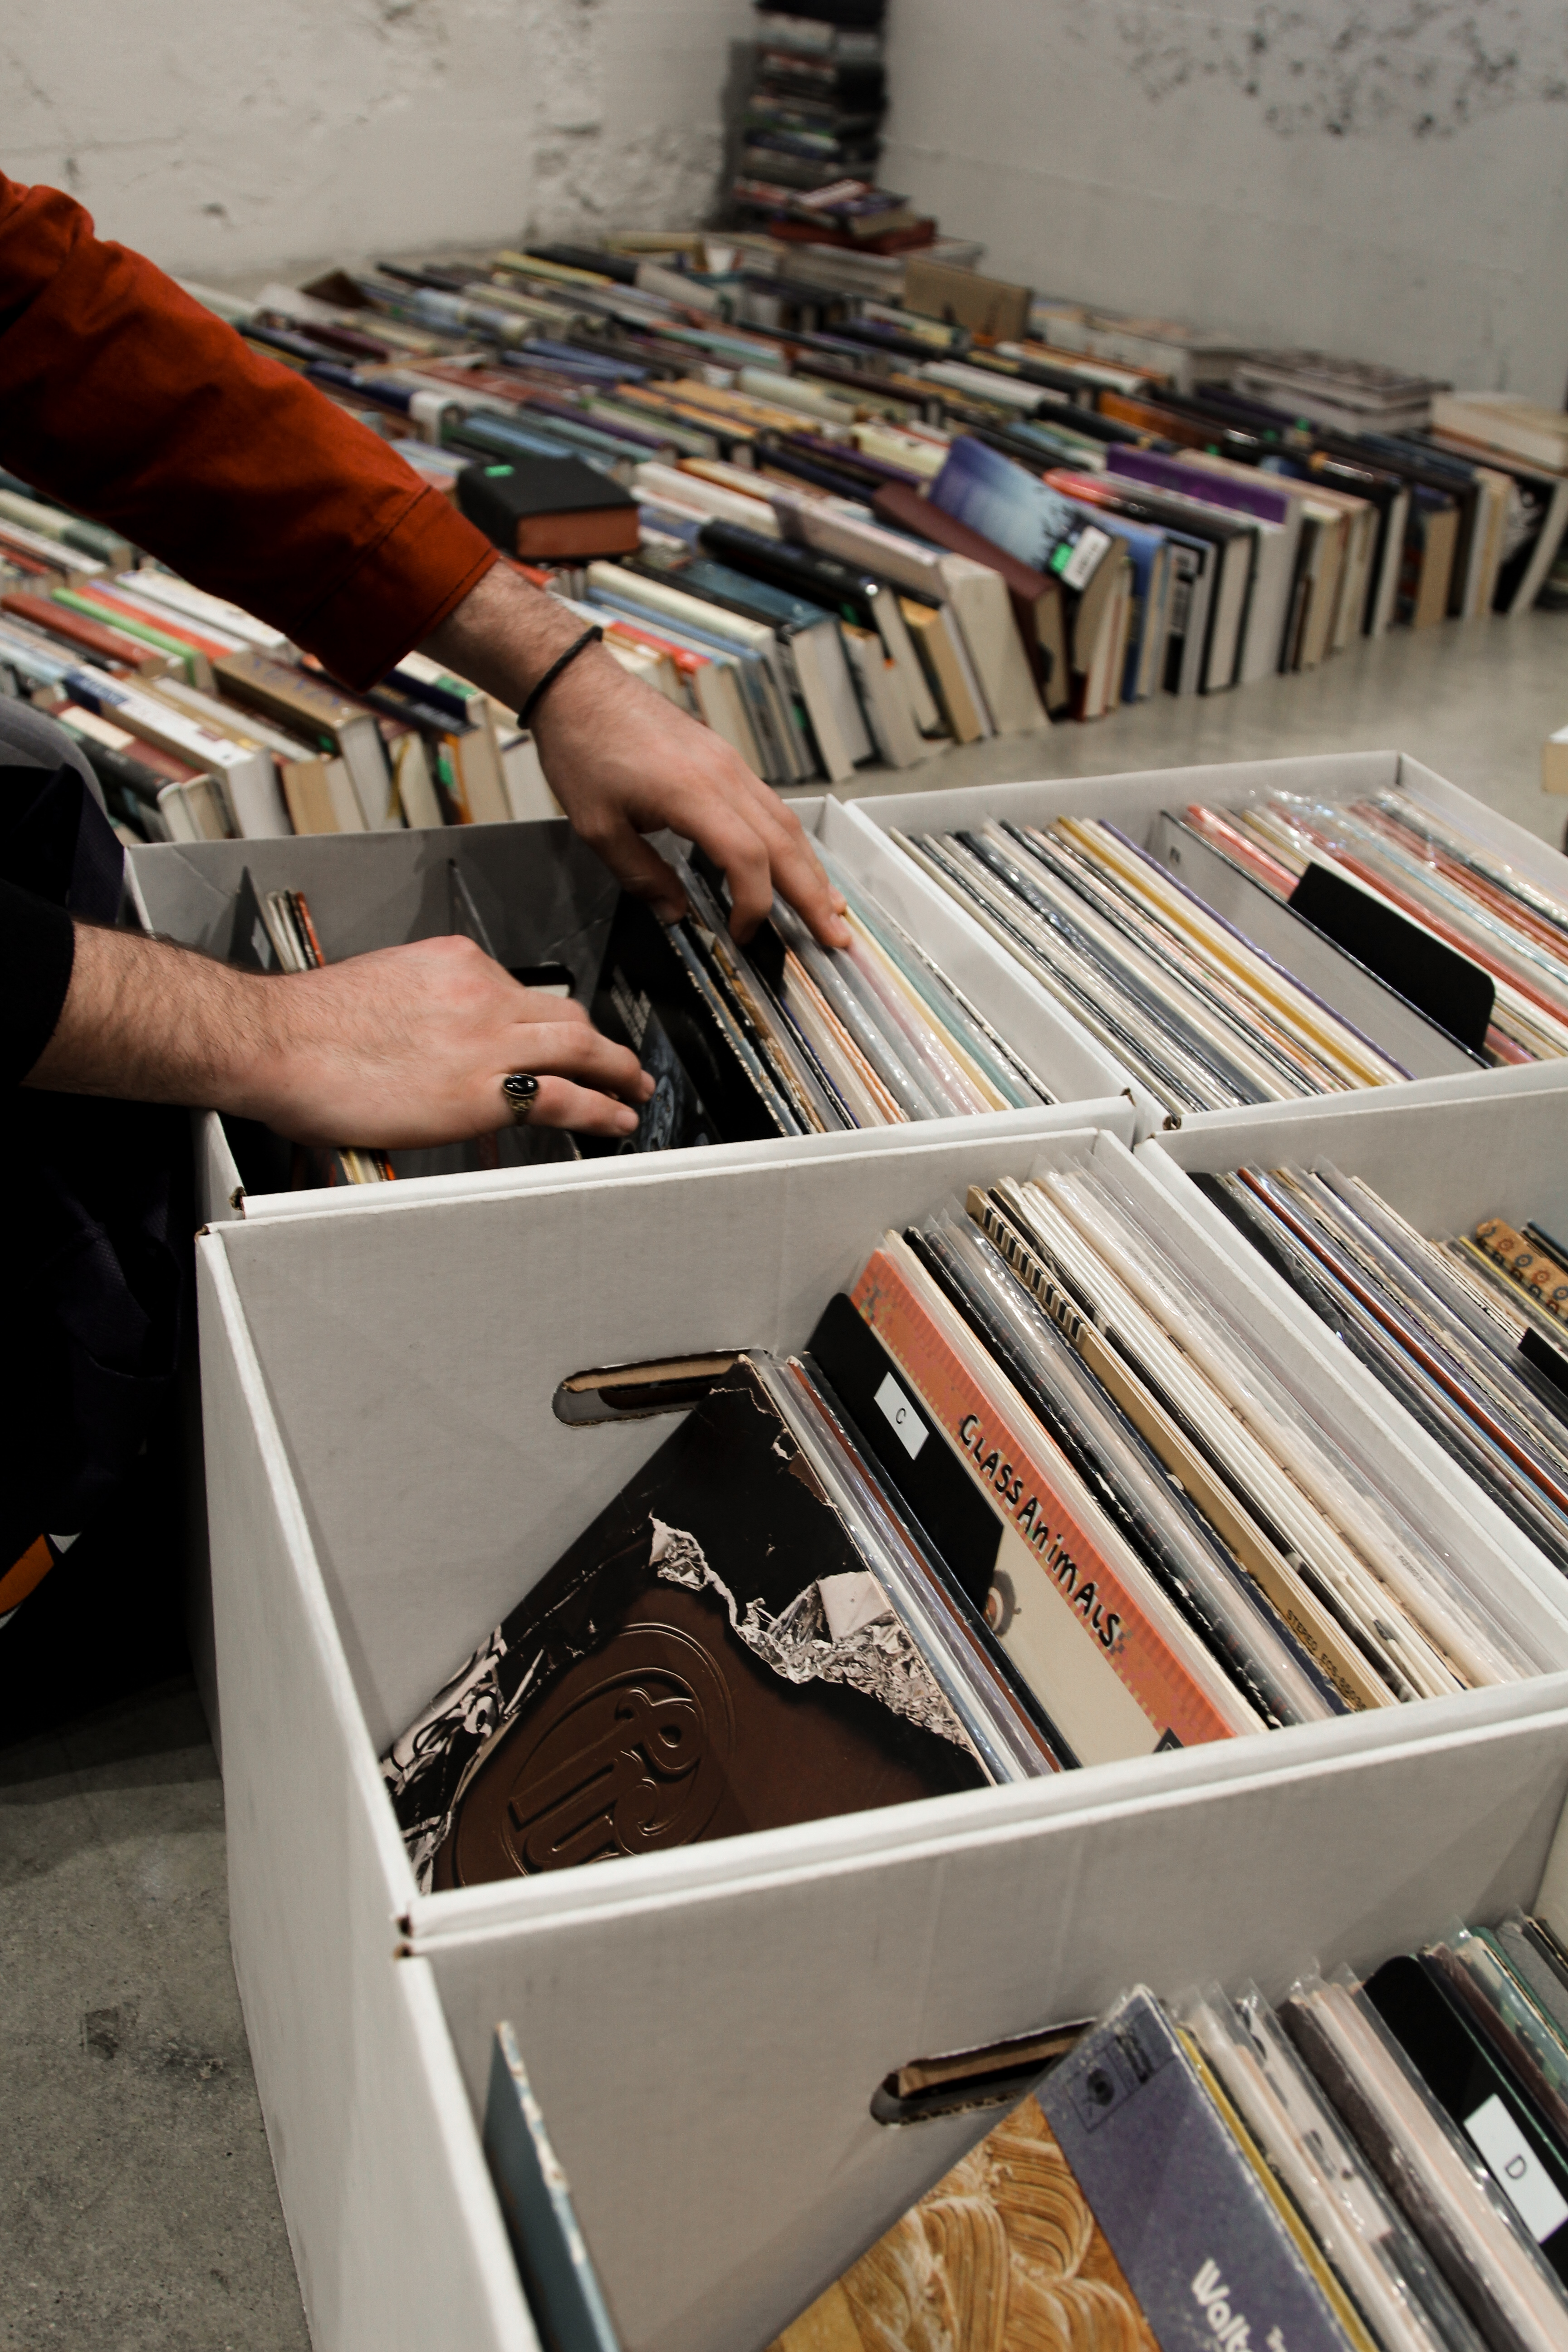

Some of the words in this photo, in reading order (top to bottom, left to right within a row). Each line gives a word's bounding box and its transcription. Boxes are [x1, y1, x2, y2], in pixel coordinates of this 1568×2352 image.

[896, 1407, 906, 1425] C
[1285, 1609, 1318, 1651] STEREO
[1504, 2154, 1527, 2180] D
